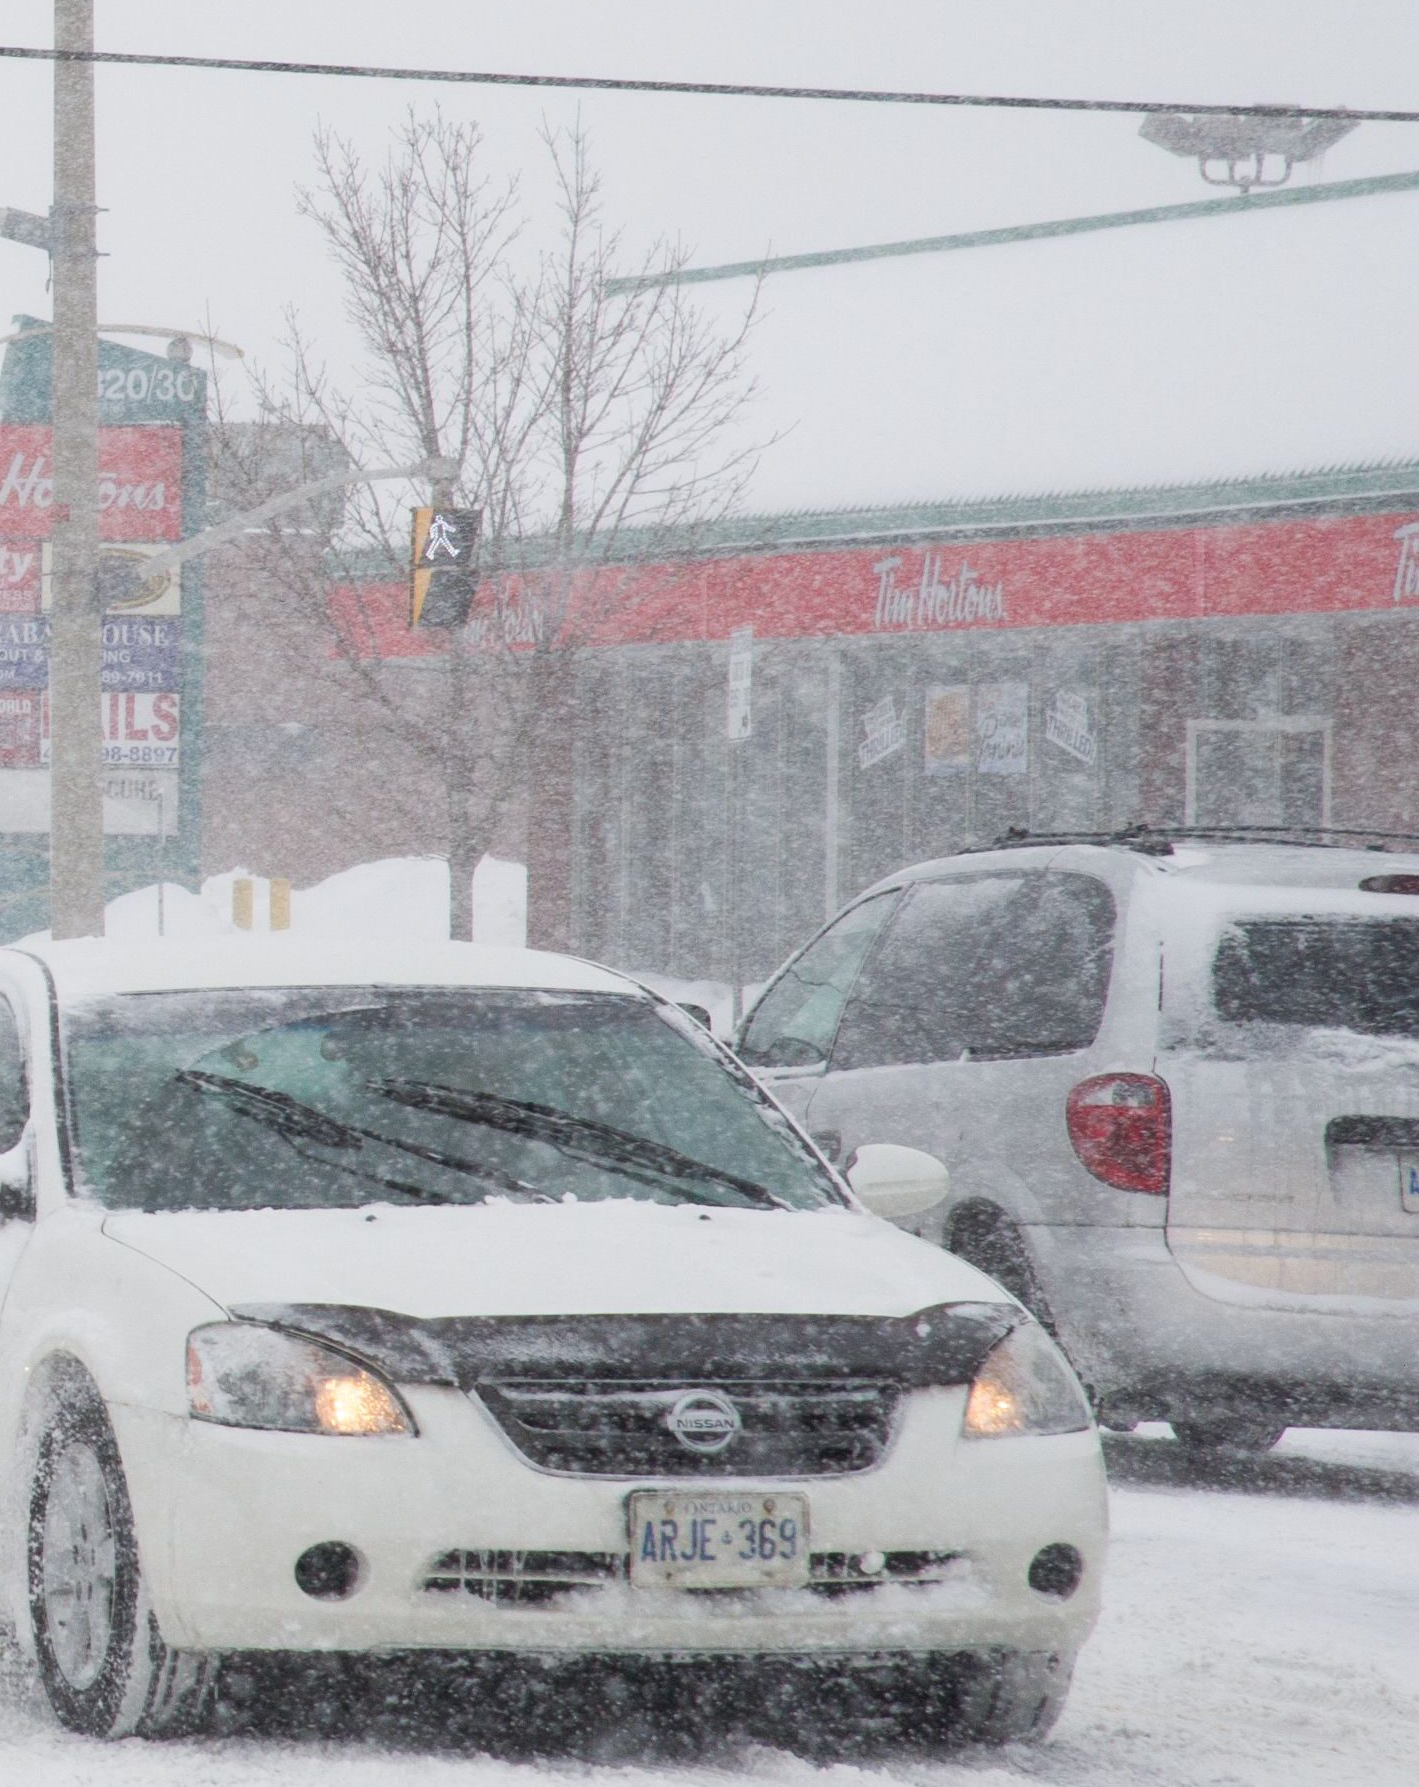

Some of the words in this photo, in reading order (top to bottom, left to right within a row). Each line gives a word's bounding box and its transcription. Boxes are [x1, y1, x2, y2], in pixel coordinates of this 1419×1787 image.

[873, 556, 913, 628] Tim
[918, 551, 1008, 625] Hortons
[101, 623, 170, 646] OUSE
[675, 1418, 736, 1430] NISSAN
[684, 1502, 753, 1515] ONTARIO
[640, 1518, 717, 1563] ARJE
[737, 1518, 798, 1561] 369
